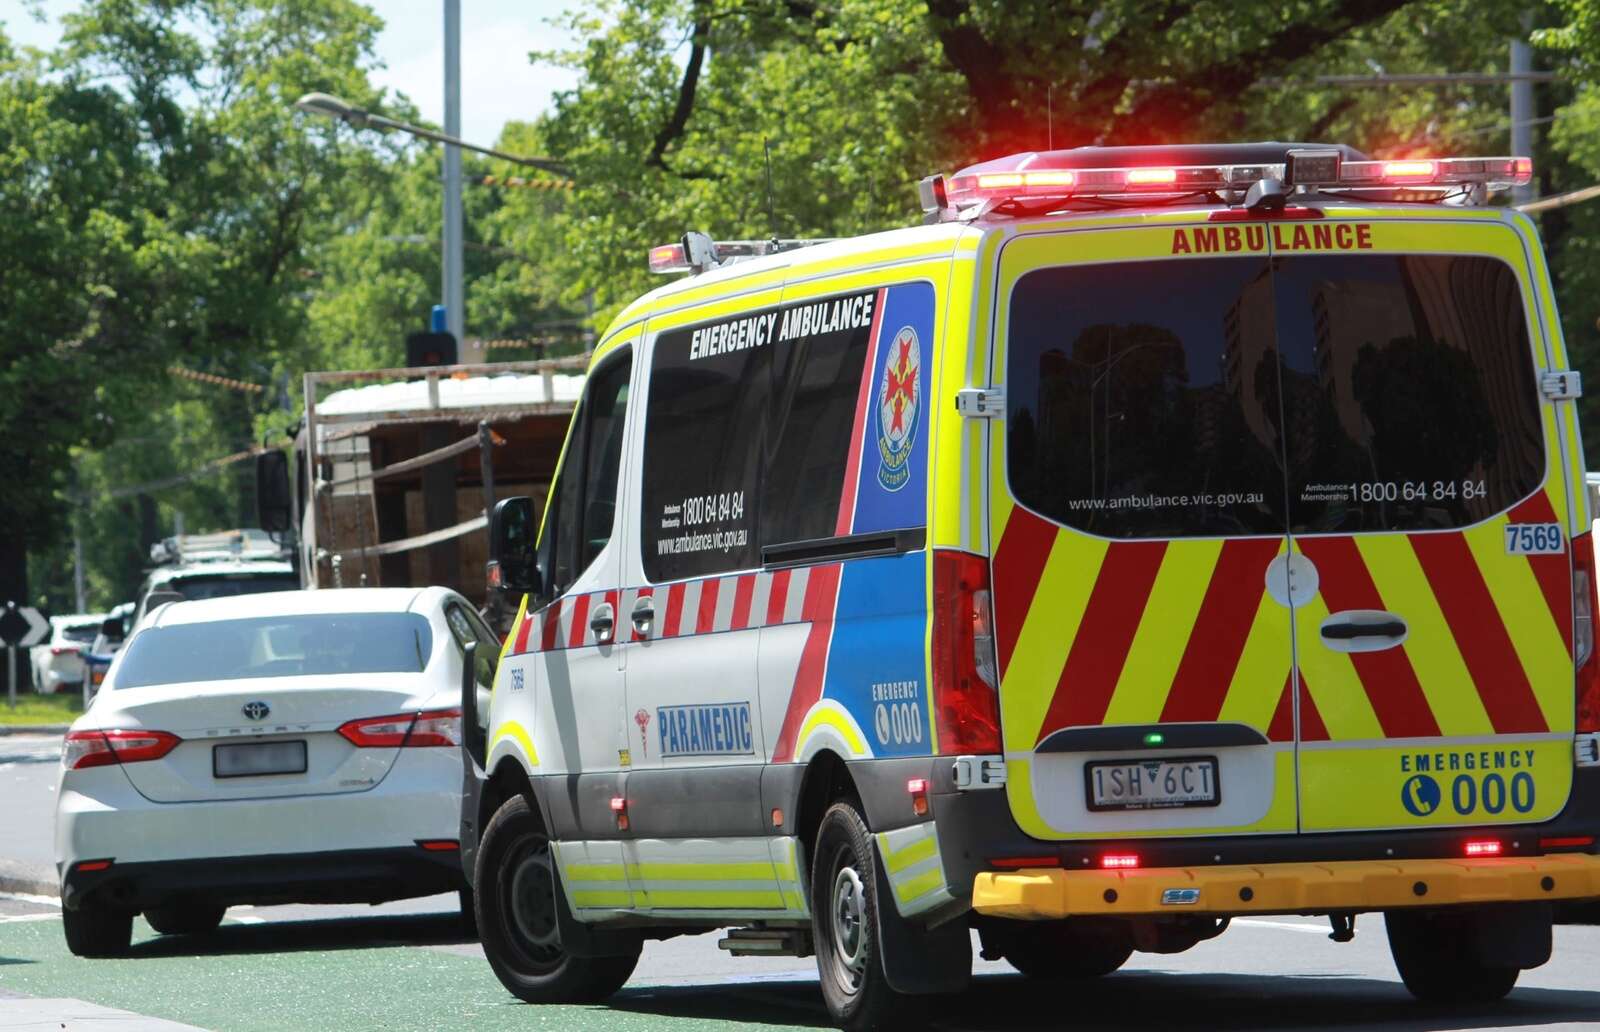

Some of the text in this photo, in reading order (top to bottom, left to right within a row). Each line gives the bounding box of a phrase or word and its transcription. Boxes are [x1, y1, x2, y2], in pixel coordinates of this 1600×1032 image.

[1171, 223, 1373, 254] AMBULANCE
[689, 294, 873, 361] EMERGENCY AMBULANCE
[1069, 492, 1264, 510] www.ambulance.vic.gov.au
[1301, 493, 1348, 502] Membership
[1305, 480, 1487, 502] Ambulance 1800 64 84 84
[683, 498, 704, 526] 1800
[705, 494, 717, 523] 64
[718, 492, 730, 521] 84
[731, 491, 744, 519] 84
[657, 528, 747, 555] www.ambulance.vic.gov.au
[1507, 525, 1561, 551] 7569
[510, 667, 524, 690] 7569
[872, 680, 918, 701] EMERGENCY
[658, 706, 751, 753] PARAMEDIC
[891, 702, 922, 744] 000
[1401, 750, 1535, 772] EMERGENCY
[1095, 767, 1142, 798] 1SH
[1164, 765, 1211, 794] 6CT
[1452, 771, 1535, 816] 000
